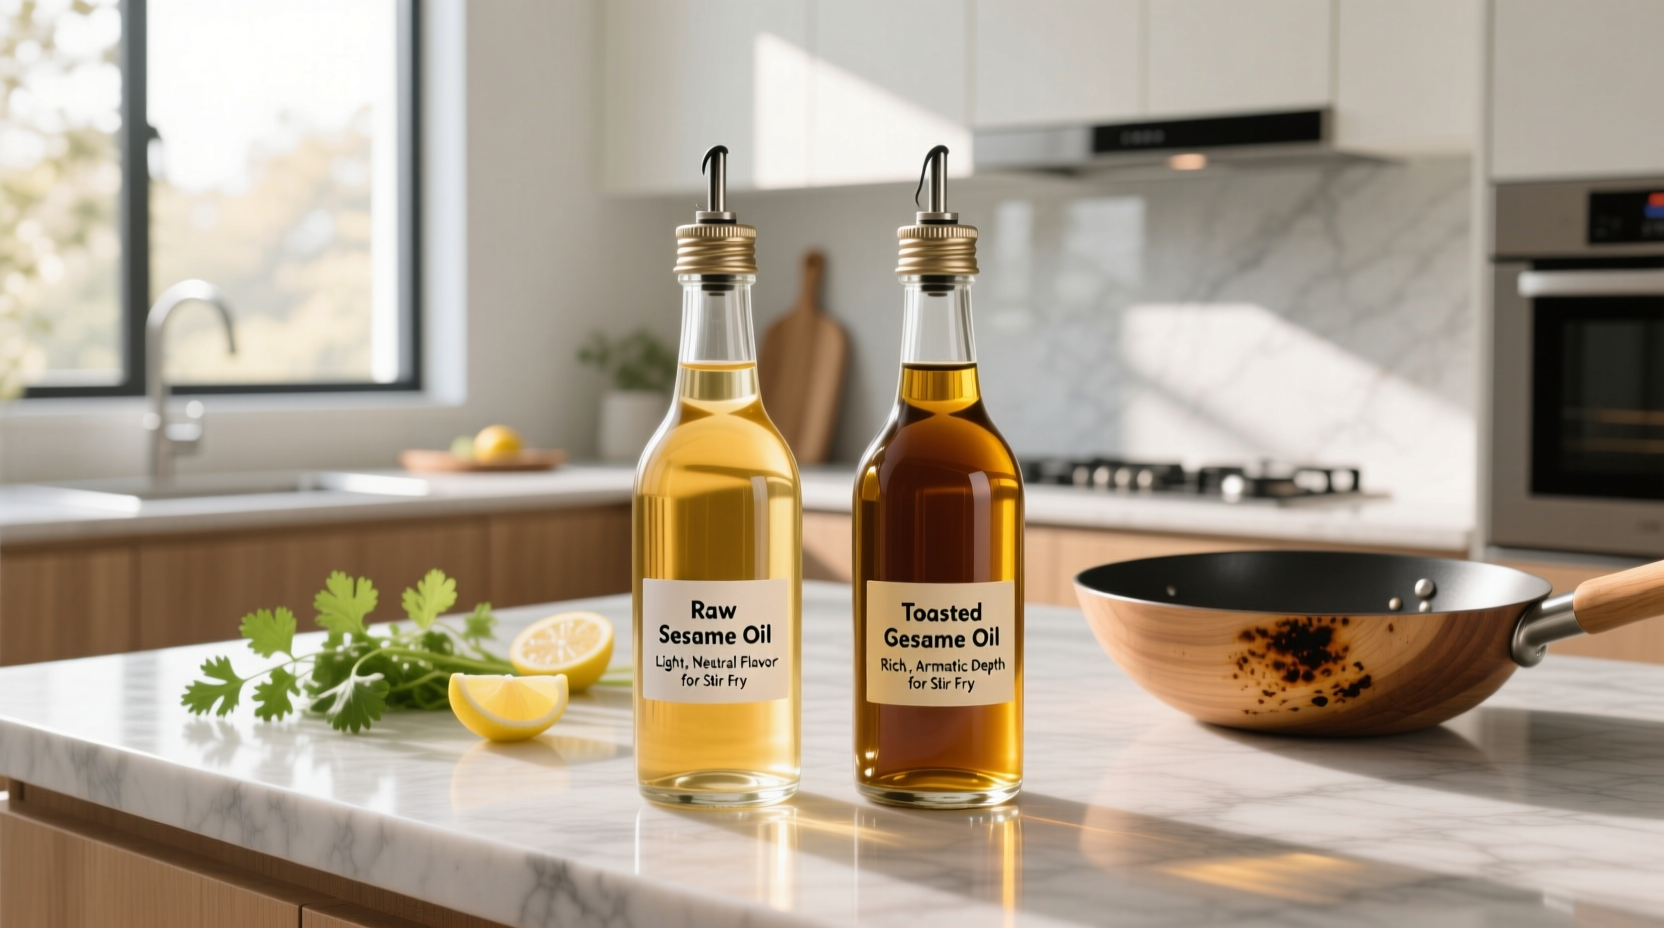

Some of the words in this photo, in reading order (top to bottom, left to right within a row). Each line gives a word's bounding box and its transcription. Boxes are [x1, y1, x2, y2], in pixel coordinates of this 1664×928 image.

[692, 600, 737, 619] Raw
[901, 602, 982, 622] Toasted
[659, 624, 737, 646] Sesame
[743, 624, 772, 645] Oil
[884, 627, 966, 648] Gesame
[972, 626, 1000, 647] Oil
[656, 655, 689, 672] Light,
[741, 655, 779, 669] Flavor
[916, 660, 968, 673] Armatic
[971, 657, 1006, 675] Depth
[681, 673, 701, 687] for
[728, 675, 748, 689] Fry
[908, 676, 928, 690] for
[955, 677, 976, 693] Fry
